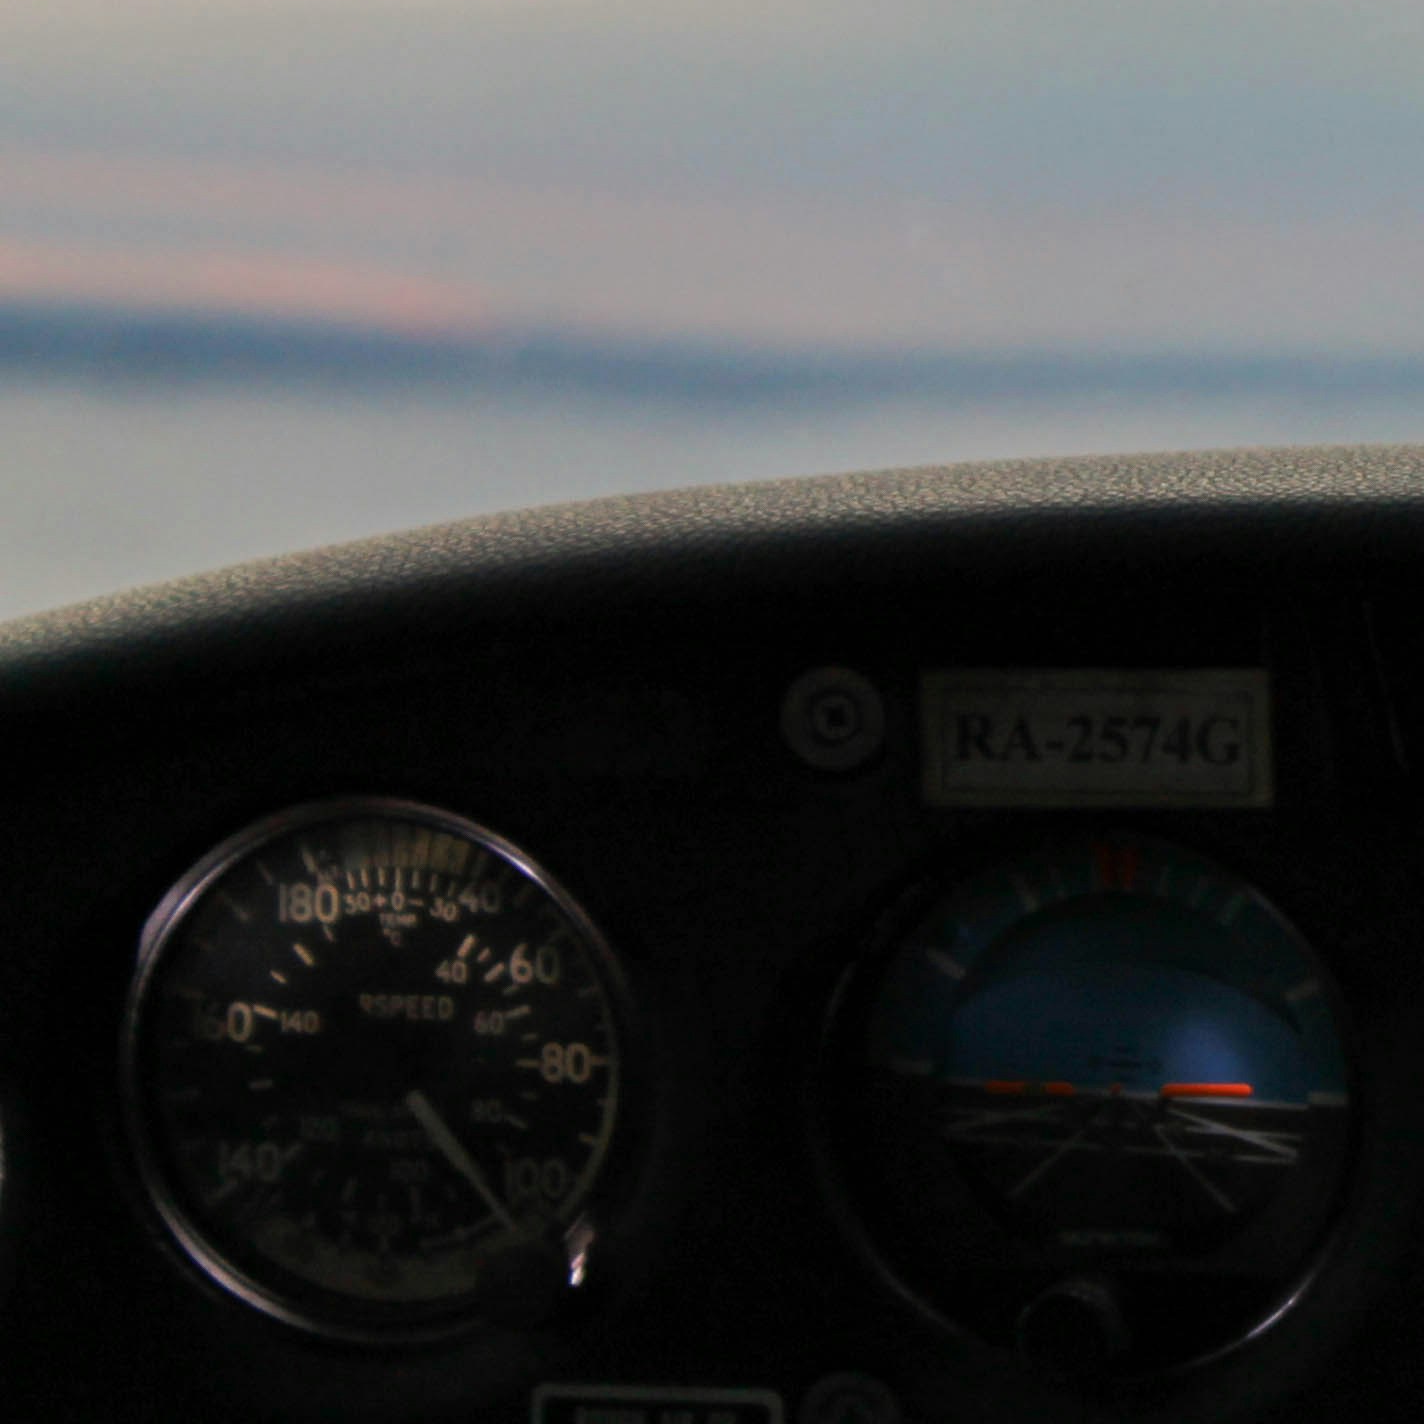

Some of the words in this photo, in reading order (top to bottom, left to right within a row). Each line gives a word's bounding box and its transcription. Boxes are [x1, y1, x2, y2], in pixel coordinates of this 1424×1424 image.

[954, 713, 1241, 766] RA-2574G
[278, 882, 341, 926] 180
[539, 1041, 594, 1084] 80
